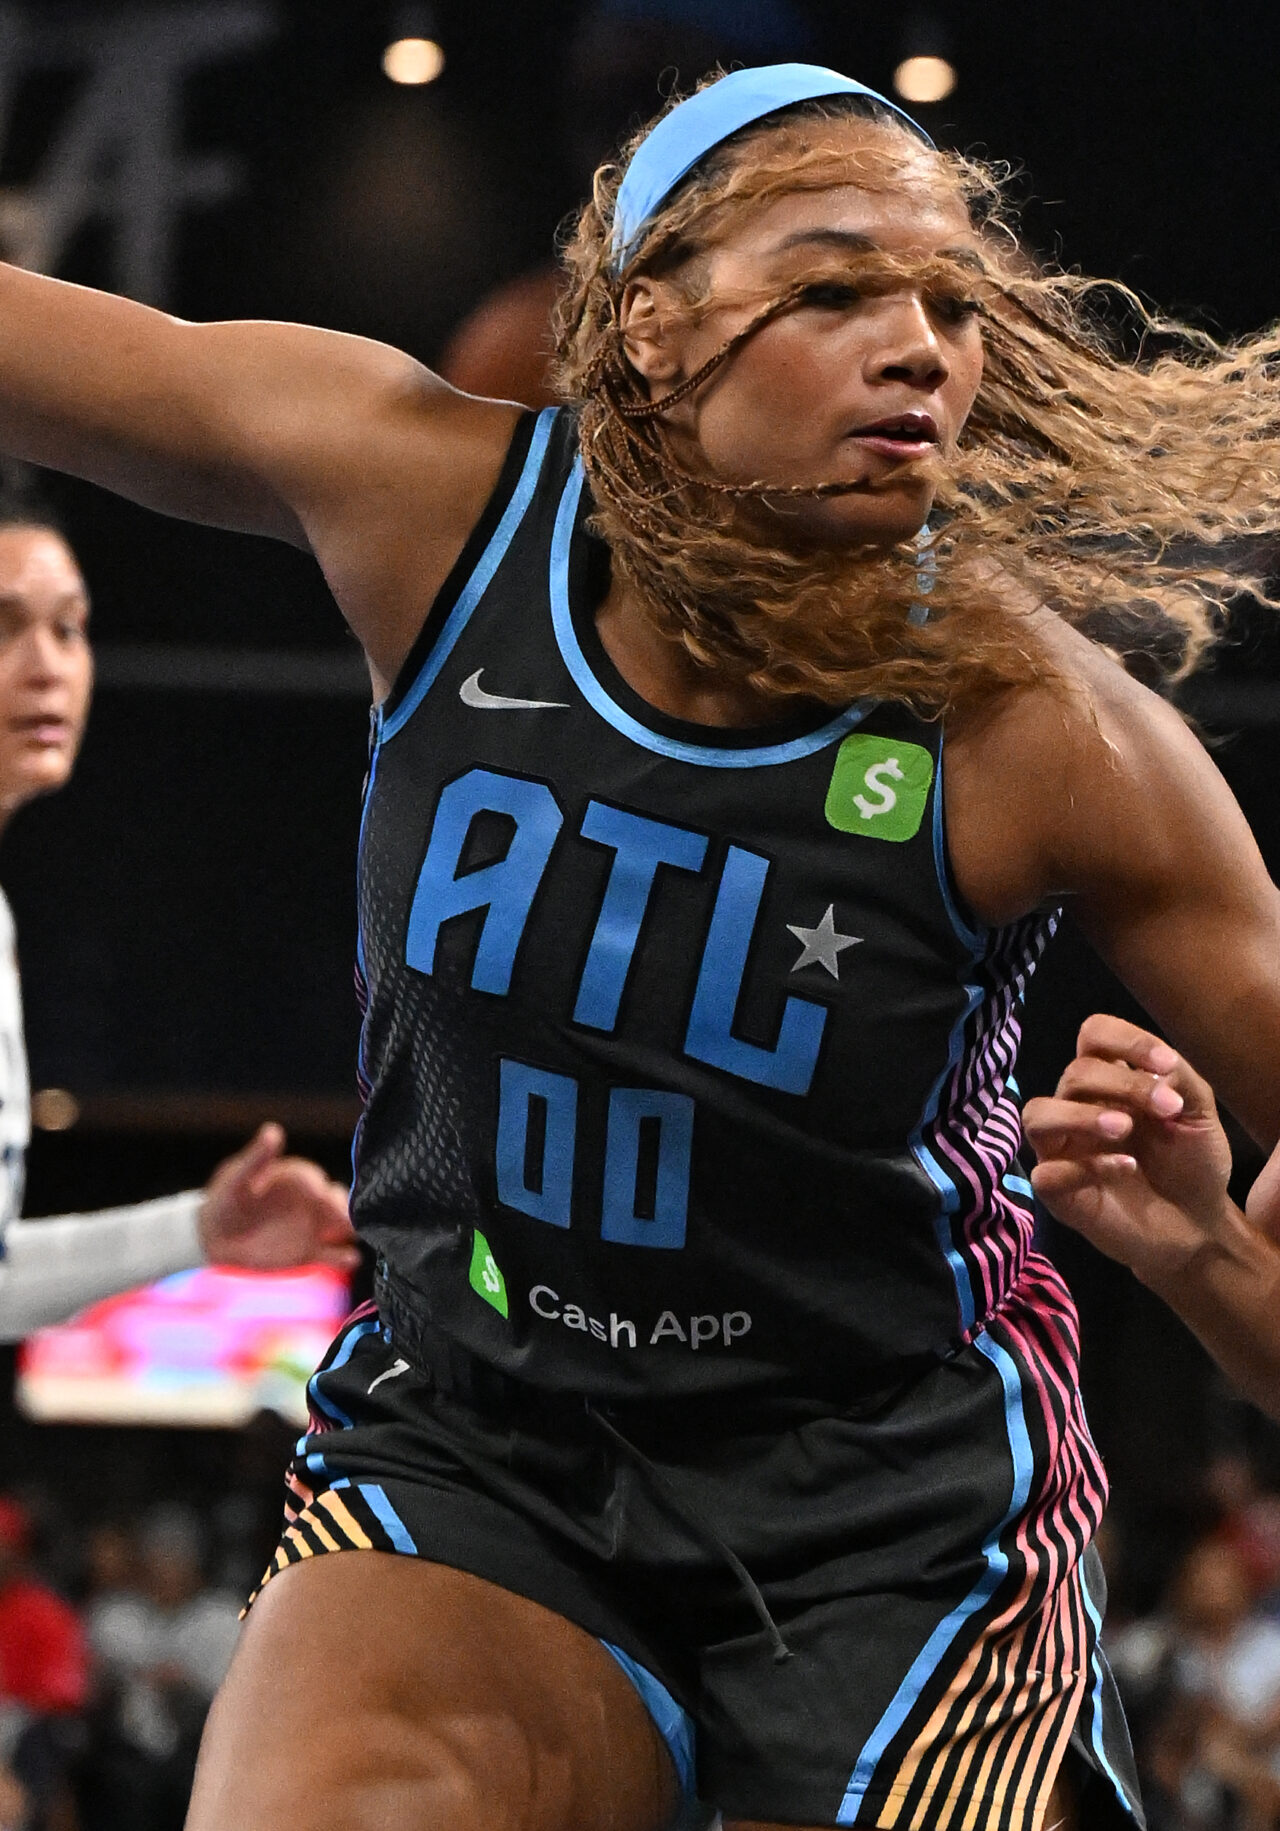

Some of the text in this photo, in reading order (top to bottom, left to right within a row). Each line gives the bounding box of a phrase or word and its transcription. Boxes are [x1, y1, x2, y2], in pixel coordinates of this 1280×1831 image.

[405, 768, 828, 1096] ATL
[496, 1058, 695, 1250] 00
[528, 1285, 753, 1351] Cash App
